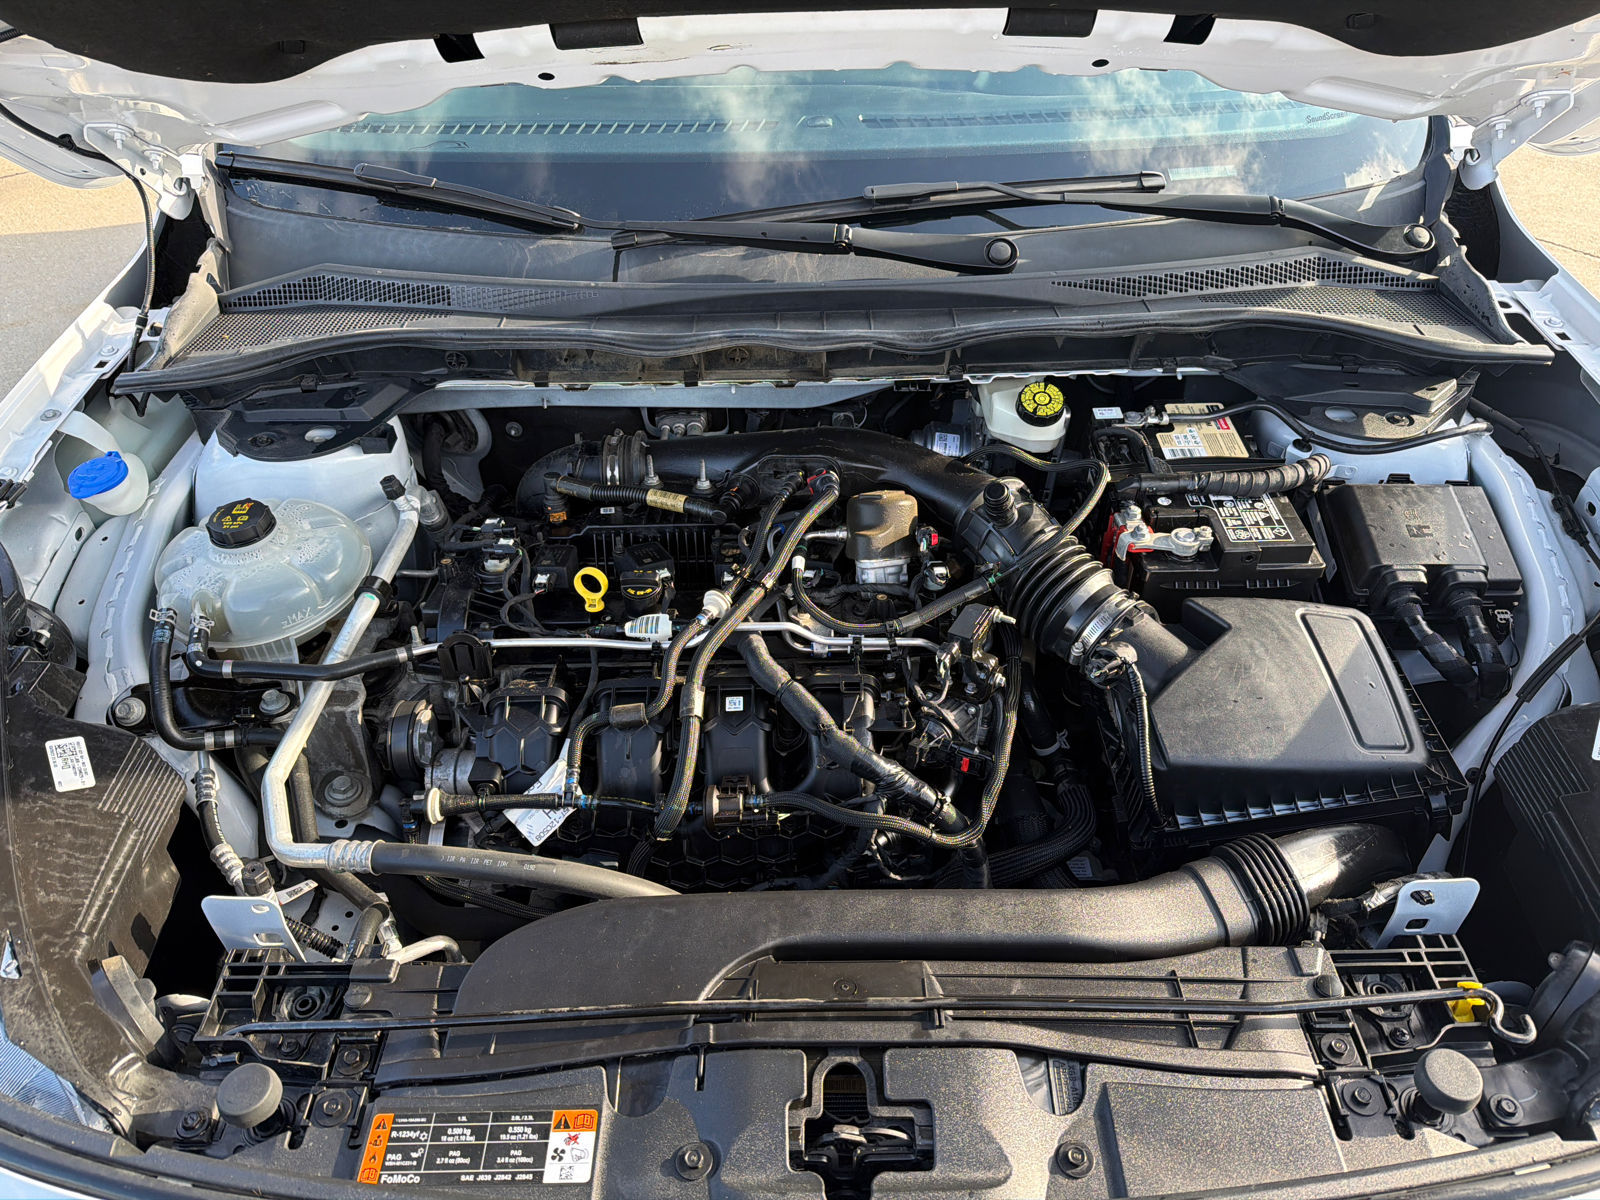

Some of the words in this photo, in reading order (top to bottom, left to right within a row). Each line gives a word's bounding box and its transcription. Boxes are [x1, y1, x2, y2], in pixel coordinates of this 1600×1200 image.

[390, 1130, 420, 1139] R-1234yf
[386, 1153, 403, 1161] PAG
[380, 1174, 421, 1184] FoMoCo
[460, 1174, 475, 1182] SAE
